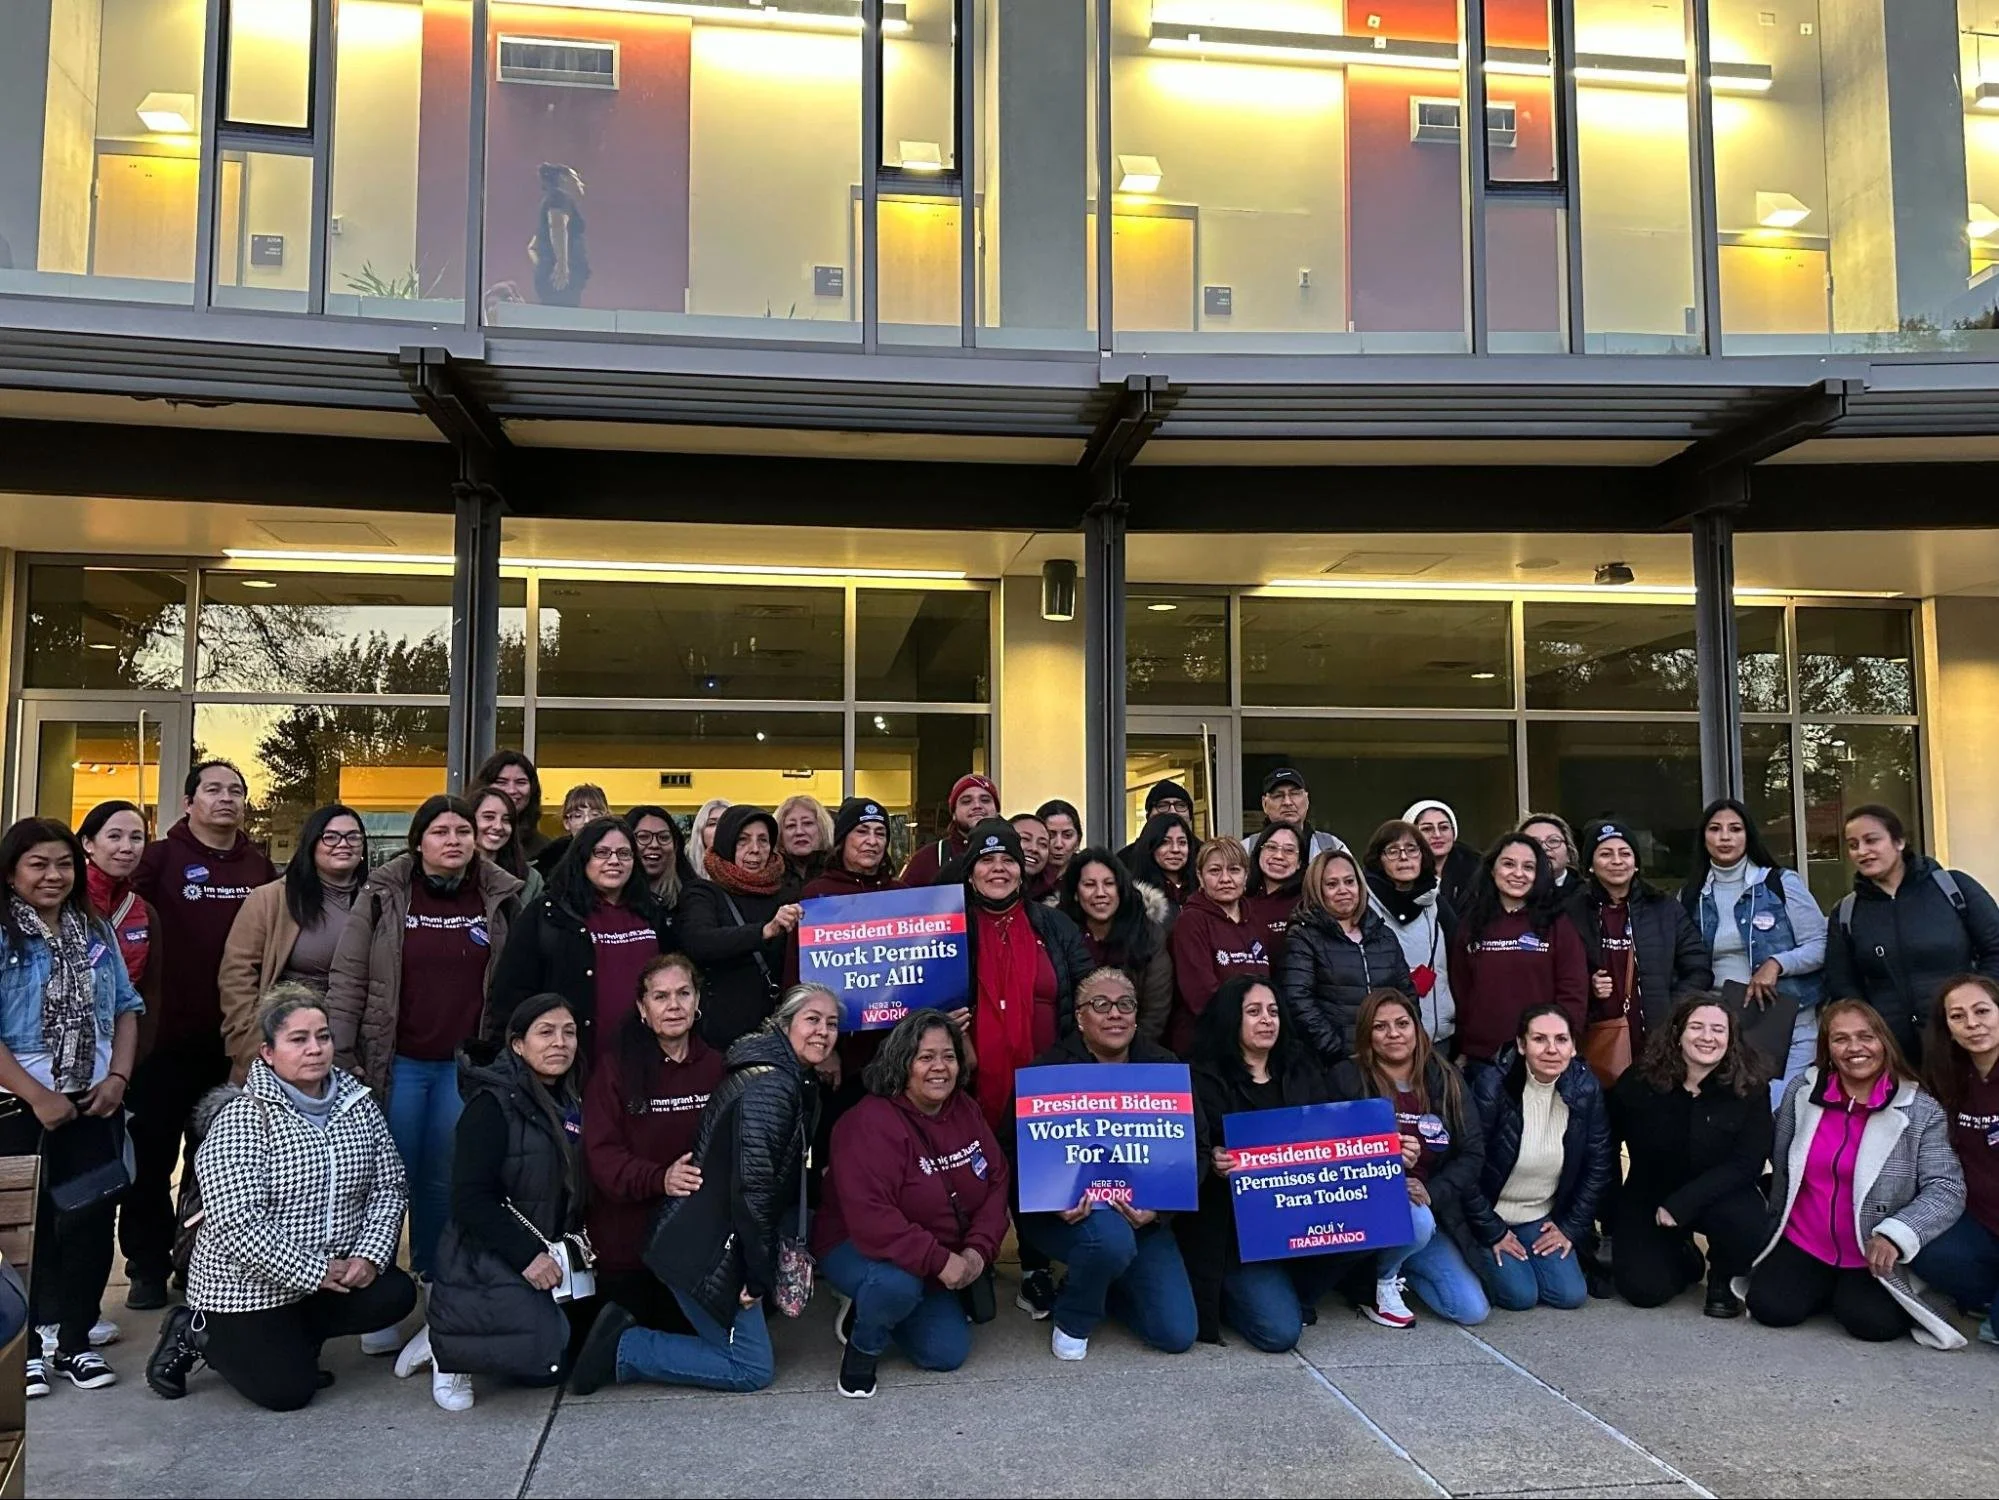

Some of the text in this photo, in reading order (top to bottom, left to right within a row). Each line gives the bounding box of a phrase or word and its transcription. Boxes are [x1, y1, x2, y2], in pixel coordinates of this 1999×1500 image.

[814, 919, 951, 942] President Biden:
[810, 940, 957, 968] Work Permits
[844, 965, 924, 989] For All!
[863, 1008, 908, 1022] WORK
[869, 1001, 889, 1009] HERE
[1032, 1095, 1178, 1113] President Biden:
[1028, 1118, 1184, 1140] Work Permits
[1065, 1143, 1150, 1164] For All!
[1239, 1141, 1390, 1167] Presidente Biden:
[1091, 1180, 1112, 1188] HERE
[1235, 1160, 1401, 1195] ¡Permisos de Trabajo
[1086, 1188, 1132, 1201] WORK
[1275, 1185, 1368, 1208] Para Todos!
[1337, 1222, 1344, 1232] Y
[1290, 1231, 1365, 1249] TRABAJANDO
